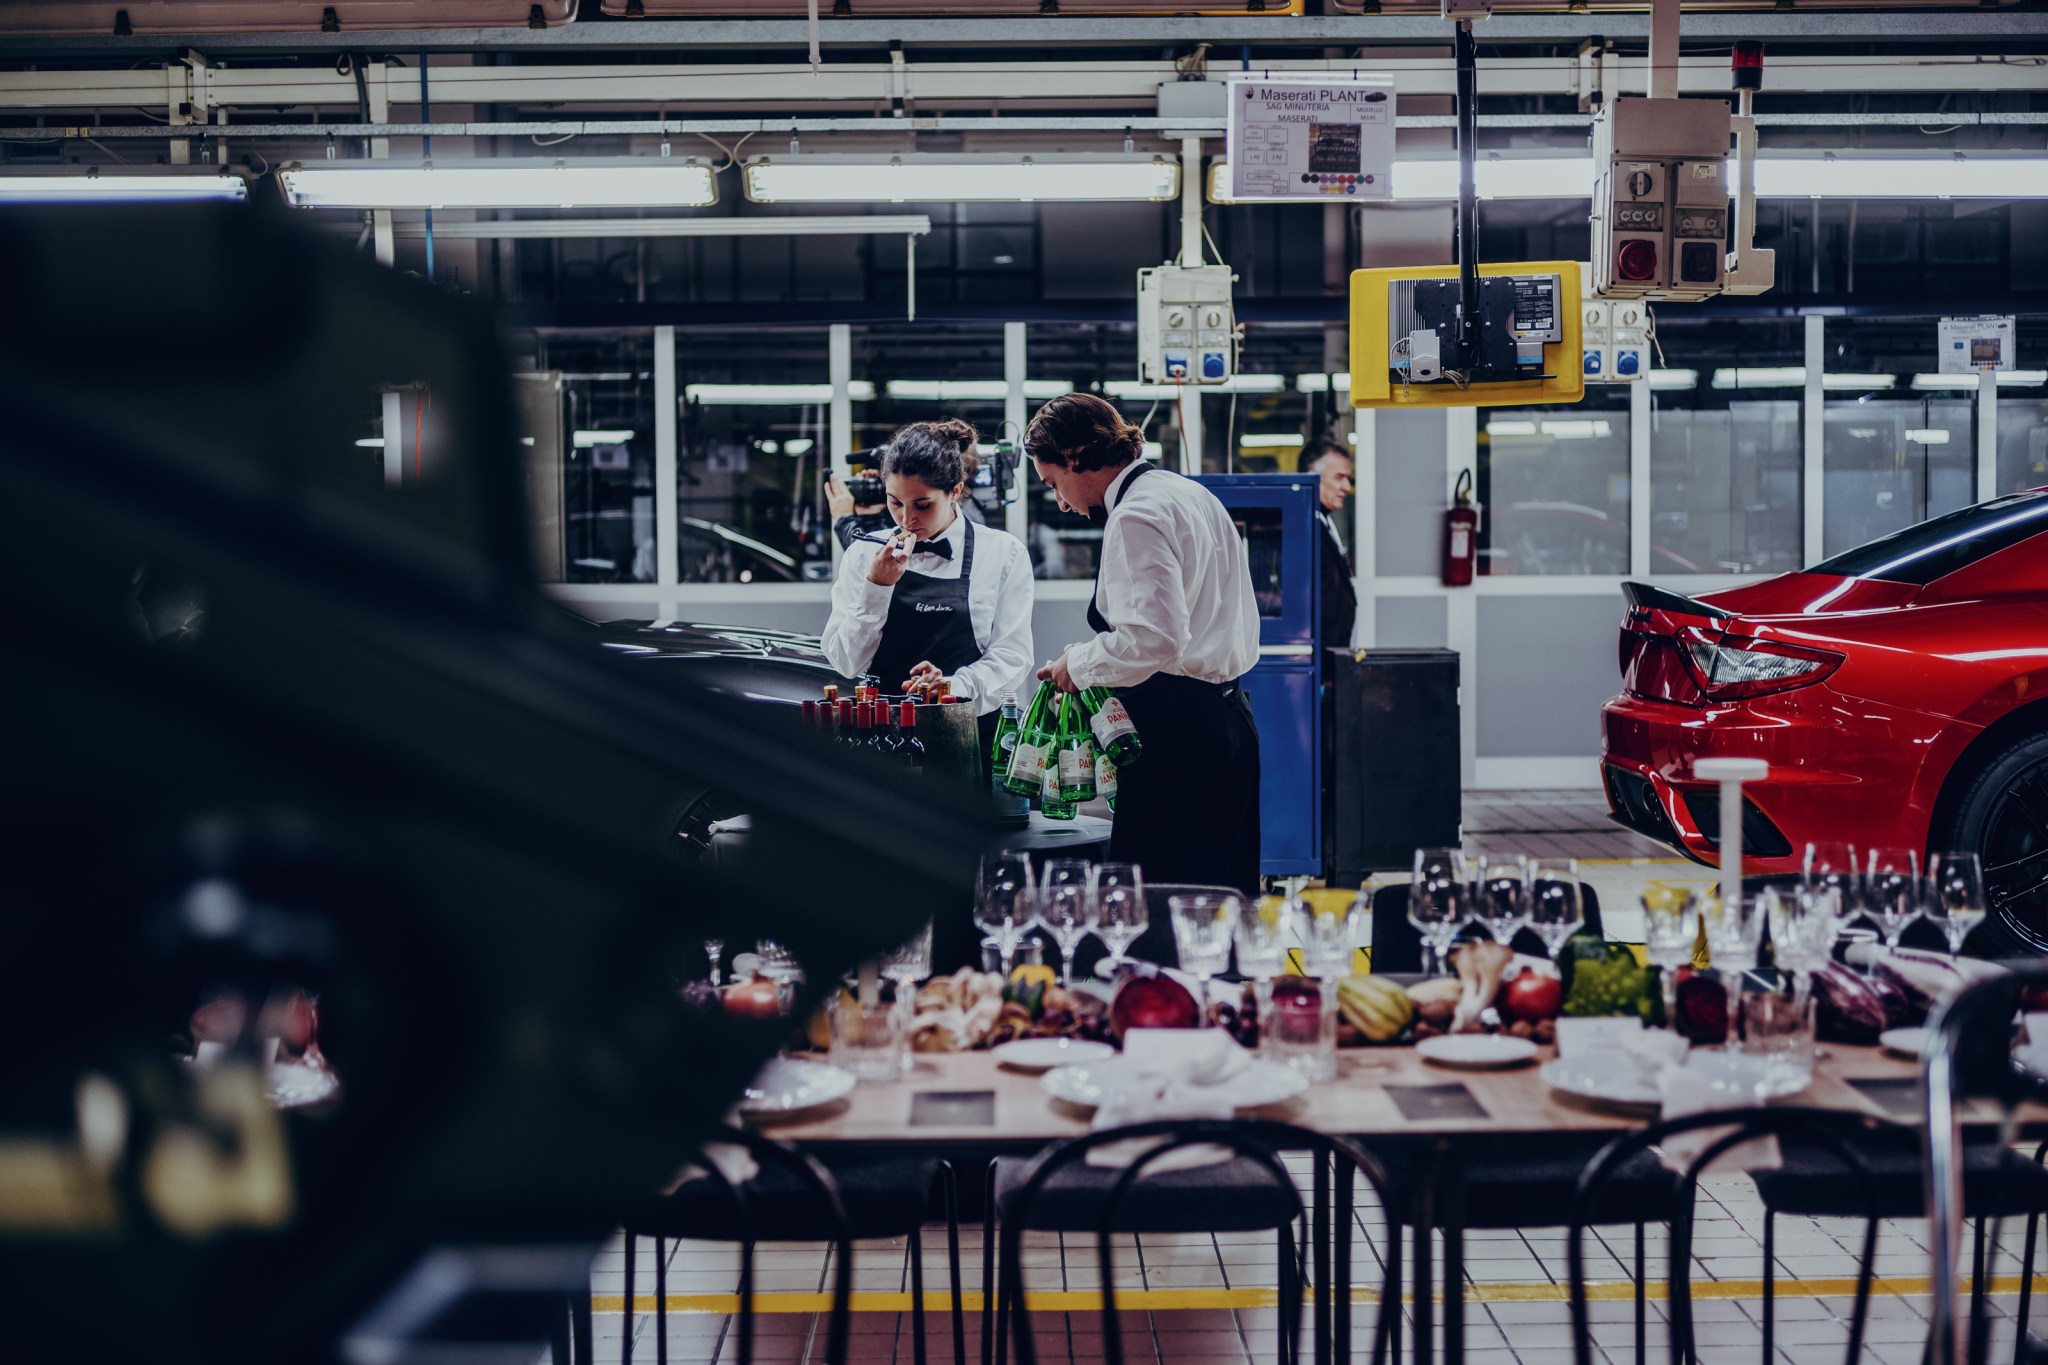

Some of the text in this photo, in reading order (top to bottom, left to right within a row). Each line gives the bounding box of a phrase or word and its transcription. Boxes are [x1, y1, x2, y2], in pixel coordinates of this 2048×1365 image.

[1261, 88, 1366, 102] Maserati PLANT
[1266, 102, 1330, 111] SAG MINUTERIA
[1278, 114, 1319, 123] MASERATI
